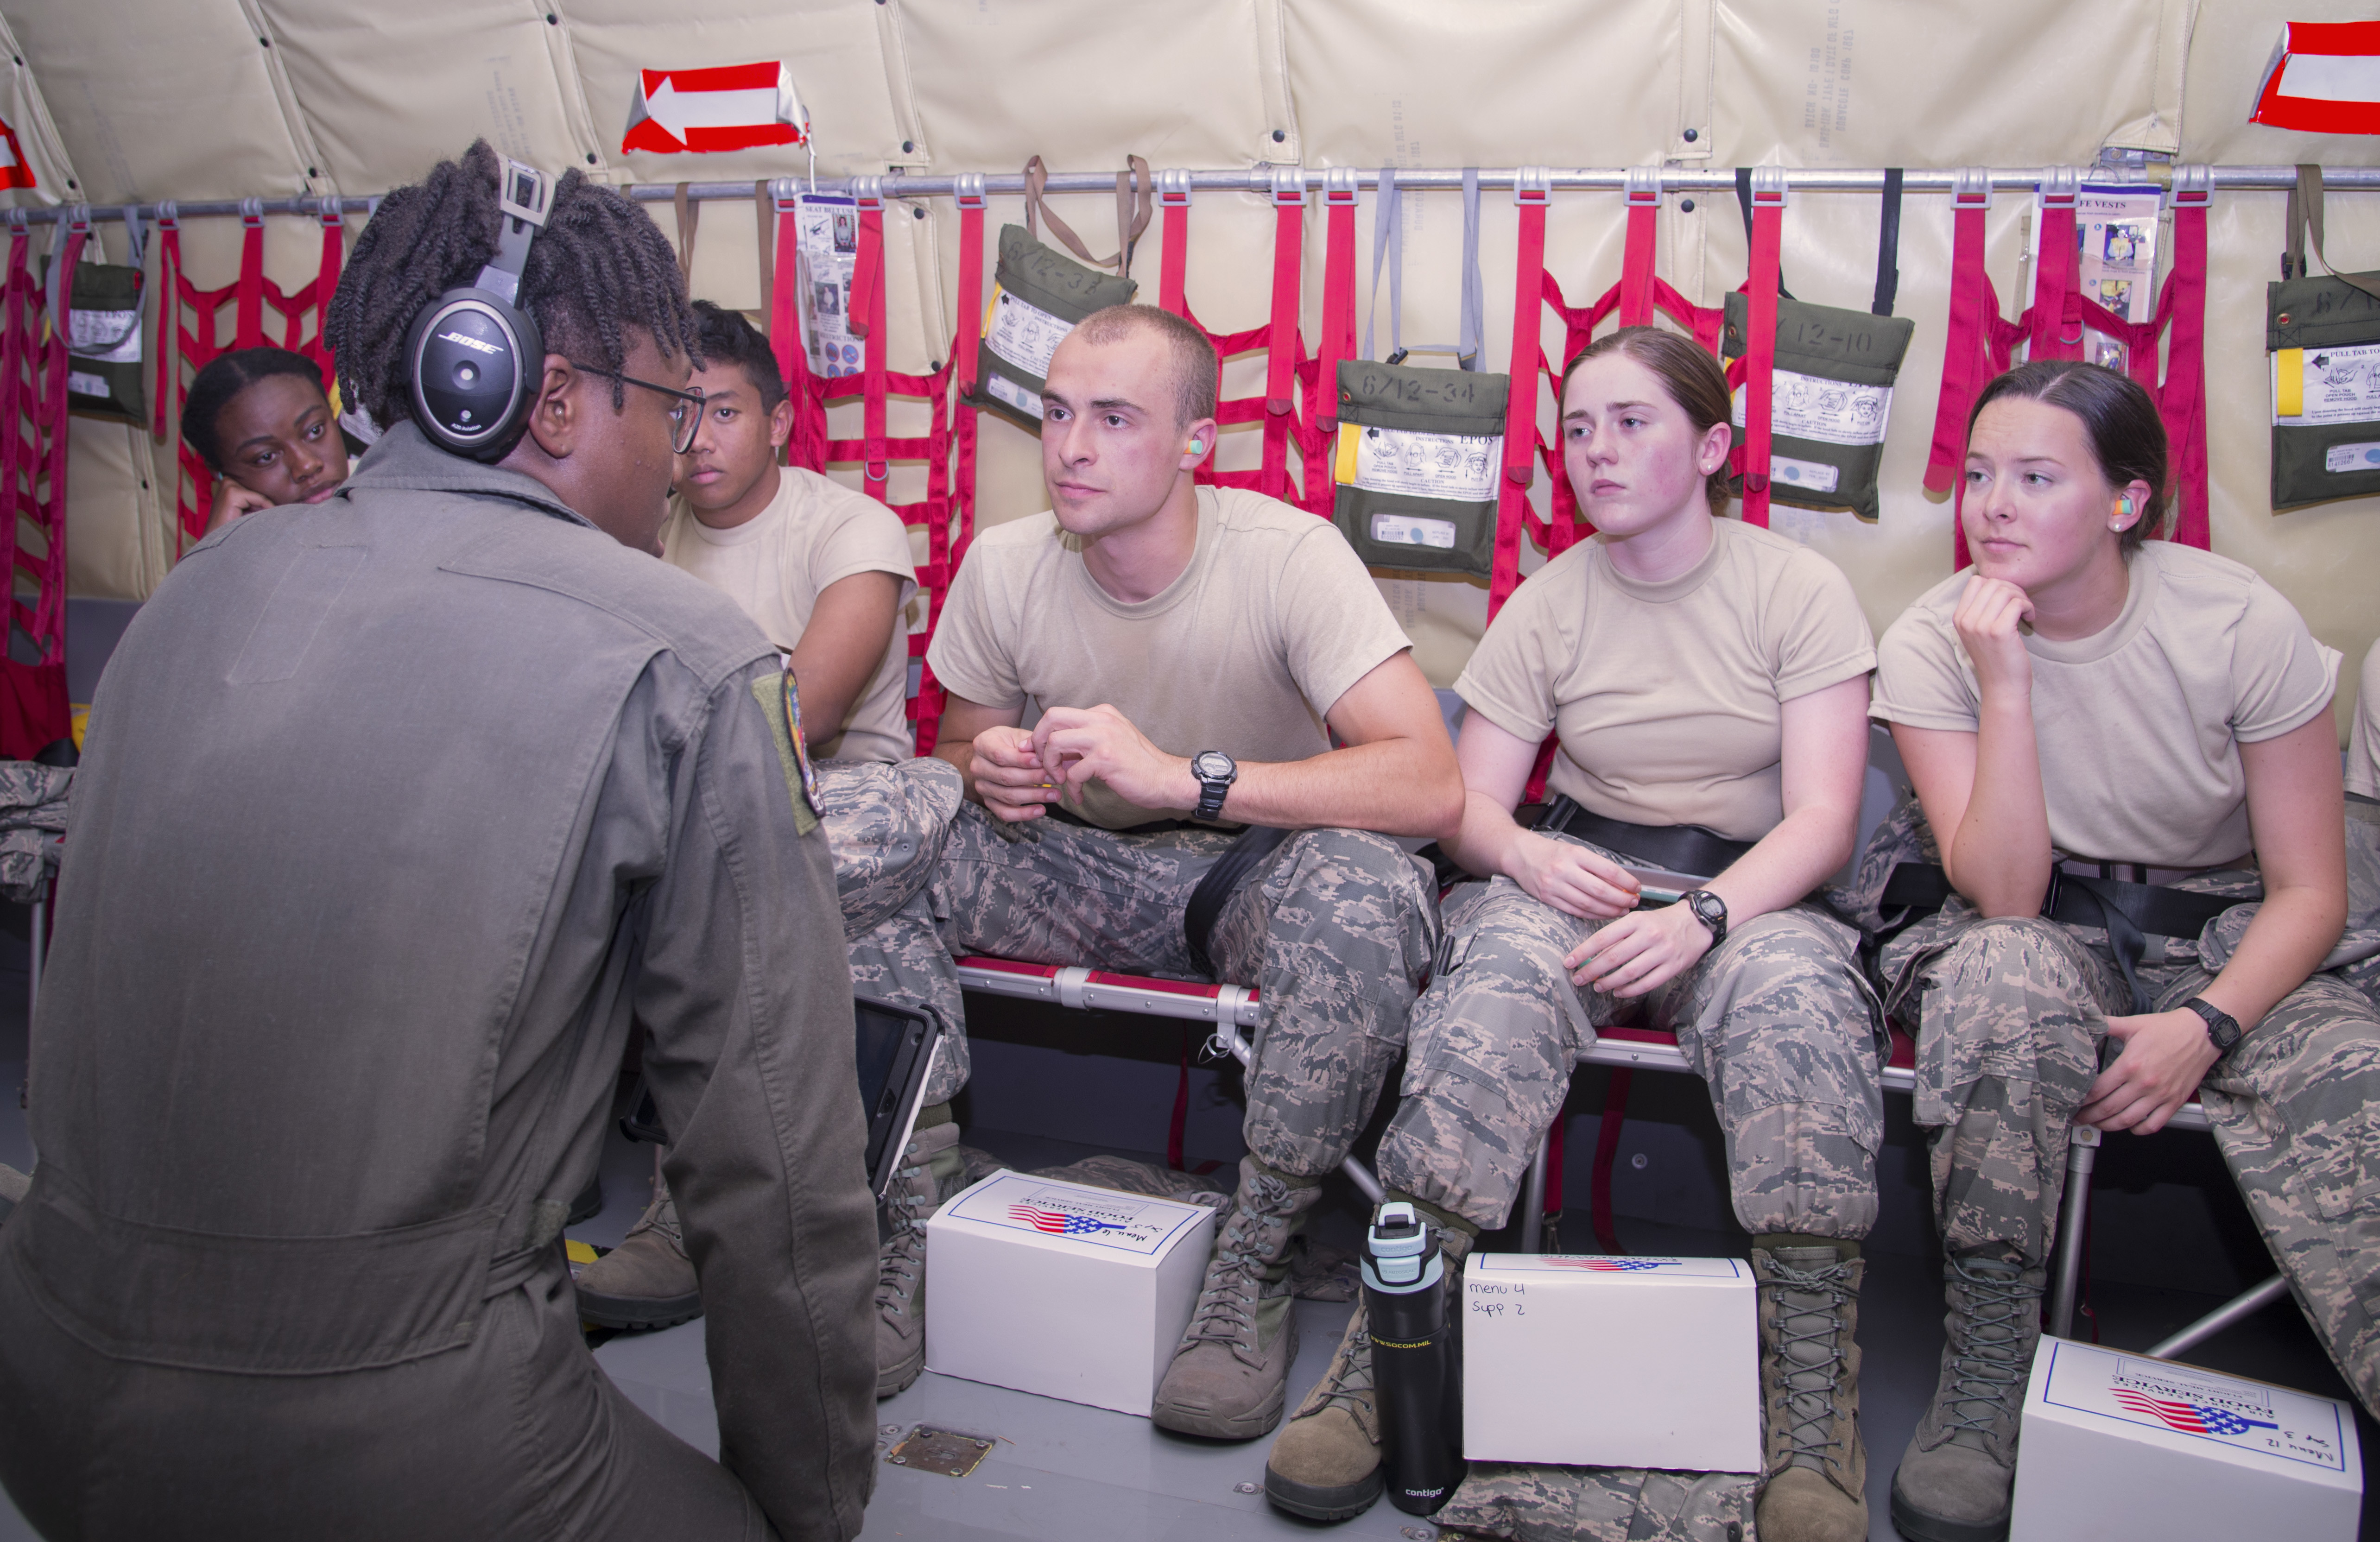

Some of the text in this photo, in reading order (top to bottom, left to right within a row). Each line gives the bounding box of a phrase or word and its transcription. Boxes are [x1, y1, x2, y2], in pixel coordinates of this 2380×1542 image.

[2095, 200, 2126, 209] VESTS
[1776, 318, 1871, 352] /12-10
[438, 332, 504, 354] BOSE
[1362, 375, 1475, 403] 6/12-34
[1460, 436, 1493, 445] EPOS
[1021, 1197, 1086, 1212] SERVICE
[1088, 1210, 1134, 1220] FOOD
[1116, 1230, 1148, 1241] Menu
[1470, 1283, 1525, 1295] menu 4
[1472, 1301, 1525, 1317] Supp 2
[2112, 1374, 2203, 1399] SERVICE
[2114, 1380, 2184, 1399] SERVICES
[2192, 1398, 2241, 1411] FORCE
[2209, 1397, 2275, 1415] FOOD
[2247, 1409, 2275, 1419] AIR
[2265, 1438, 2334, 1461] Menu 12
[1405, 1488, 1442, 1498] contigo
